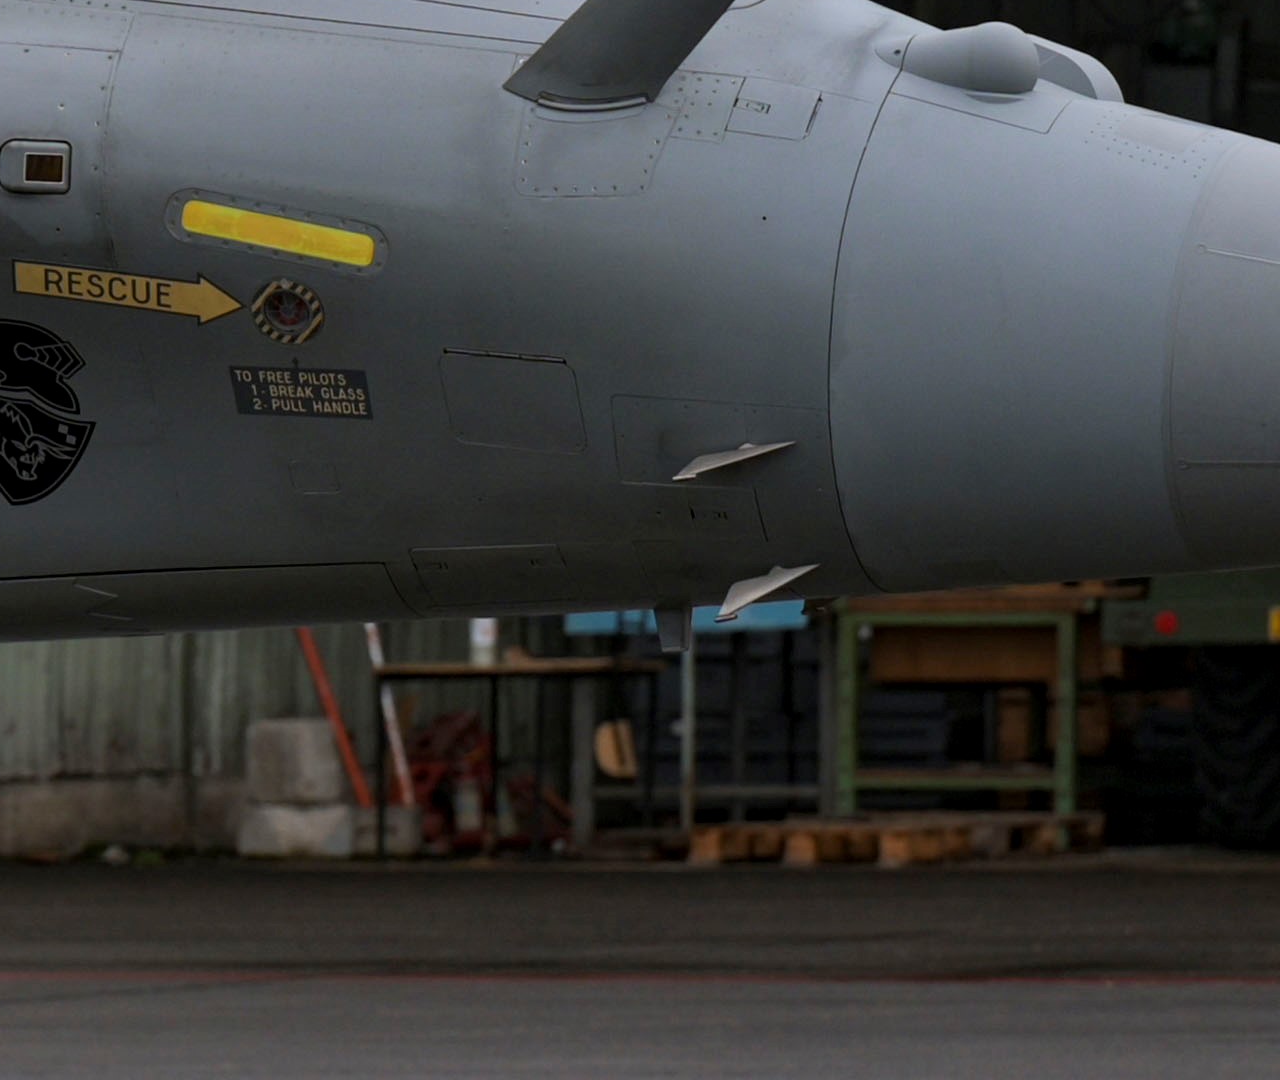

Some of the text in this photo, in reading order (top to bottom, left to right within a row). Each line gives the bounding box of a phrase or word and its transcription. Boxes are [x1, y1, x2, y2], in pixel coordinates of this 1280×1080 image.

[44, 268, 172, 309] RESCUE
[234, 369, 347, 386] TO FREE PILOTS
[269, 385, 314, 398] BREAK
[320, 387, 366, 401] GLASS
[271, 399, 307, 412] PULL
[312, 401, 368, 415] HANDLE
